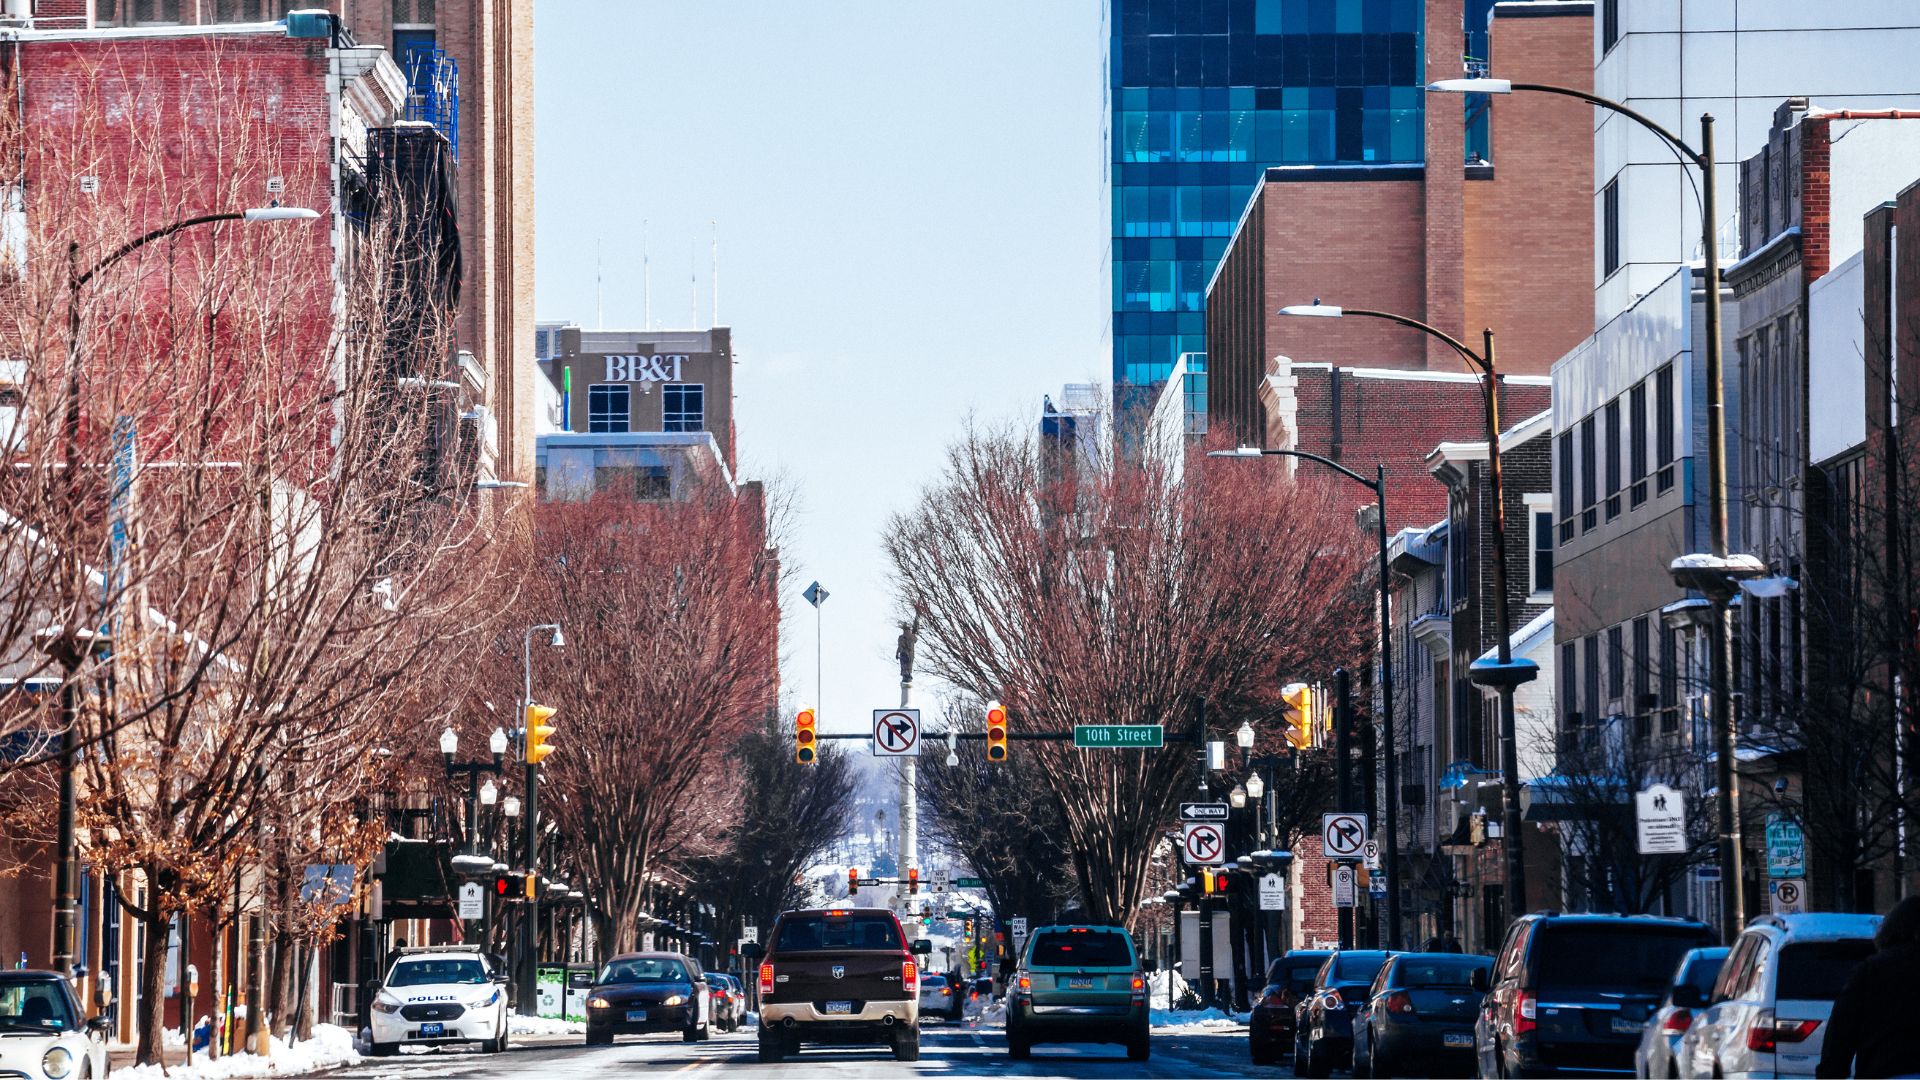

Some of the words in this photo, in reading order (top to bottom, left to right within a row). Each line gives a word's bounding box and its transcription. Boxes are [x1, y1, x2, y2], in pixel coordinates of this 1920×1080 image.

[604, 355, 689, 382] BB&T
[1086, 728, 1110, 742] 10th
[1117, 728, 1152, 742] Street
[1194, 807, 1206, 815] ONE
[1208, 807, 1222, 815] WAY
